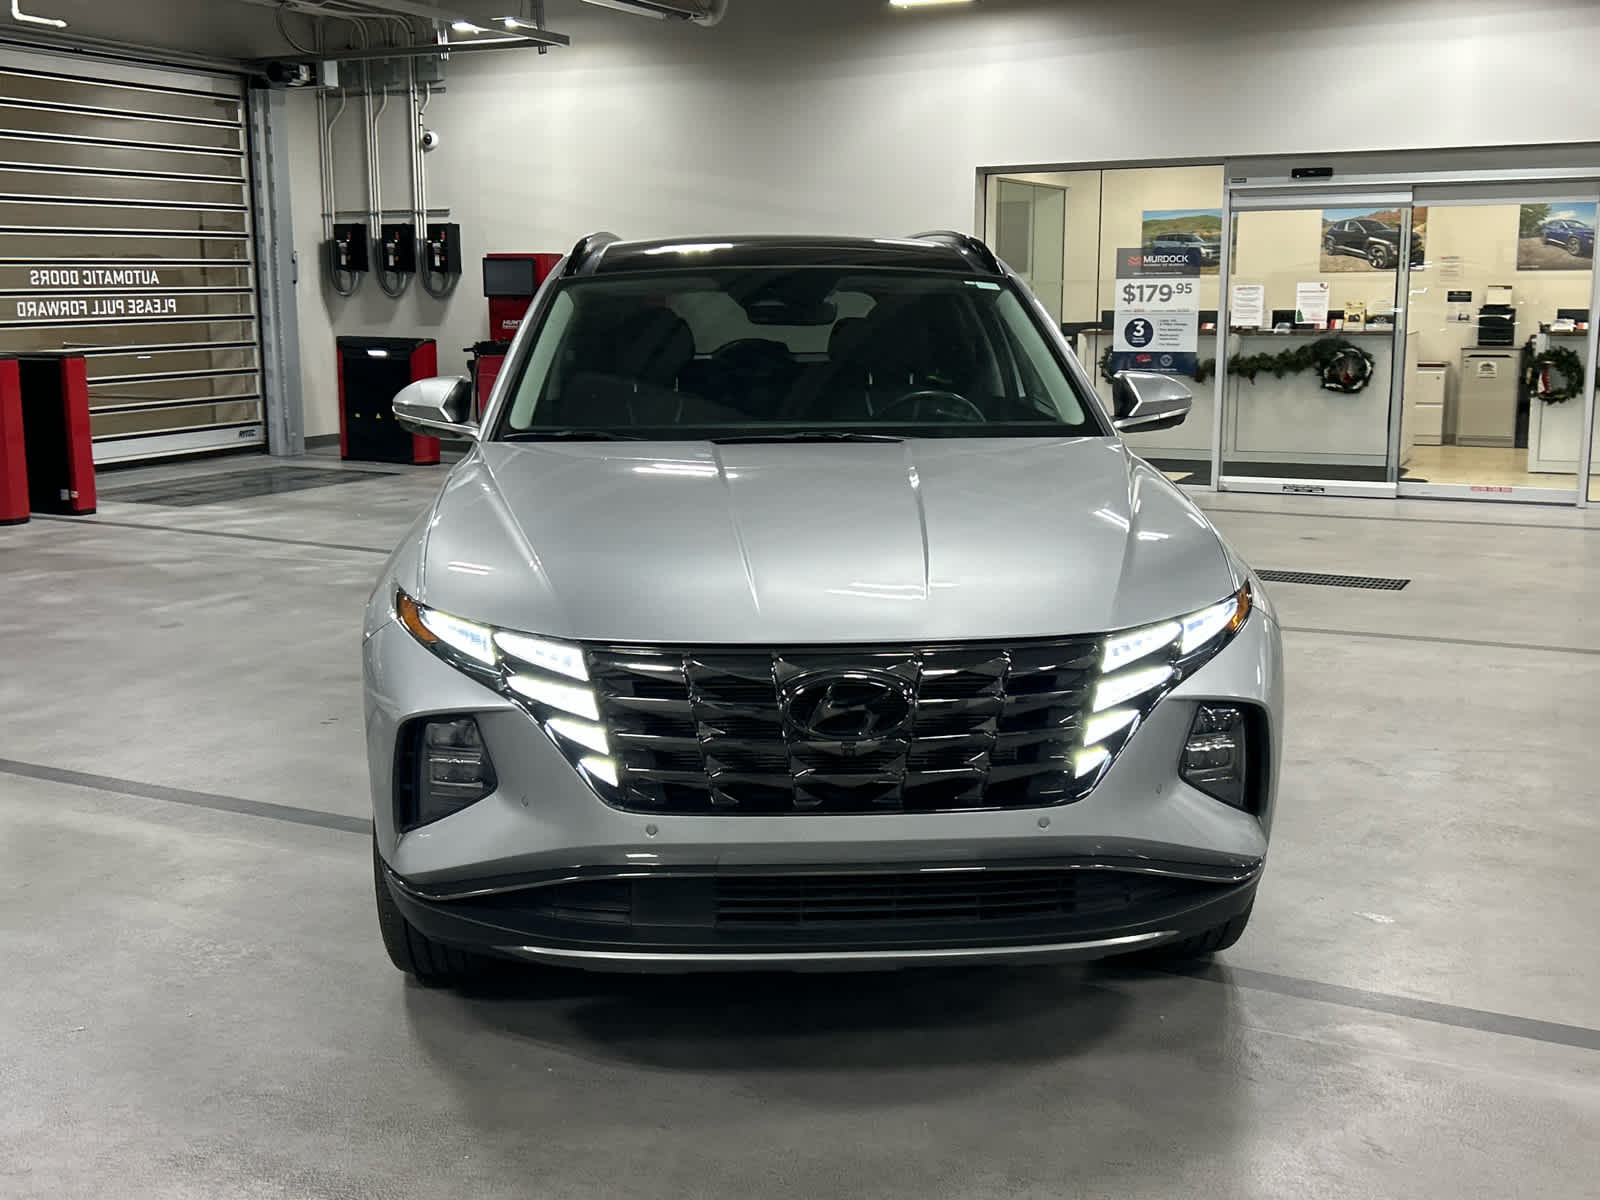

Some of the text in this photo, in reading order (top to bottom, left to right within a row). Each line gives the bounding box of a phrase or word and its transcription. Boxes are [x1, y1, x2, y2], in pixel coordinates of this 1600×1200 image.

[1143, 254, 1189, 263] MURDOCK
[1122, 283, 1193, 304] $179.95
[1132, 320, 1145, 337] 3
